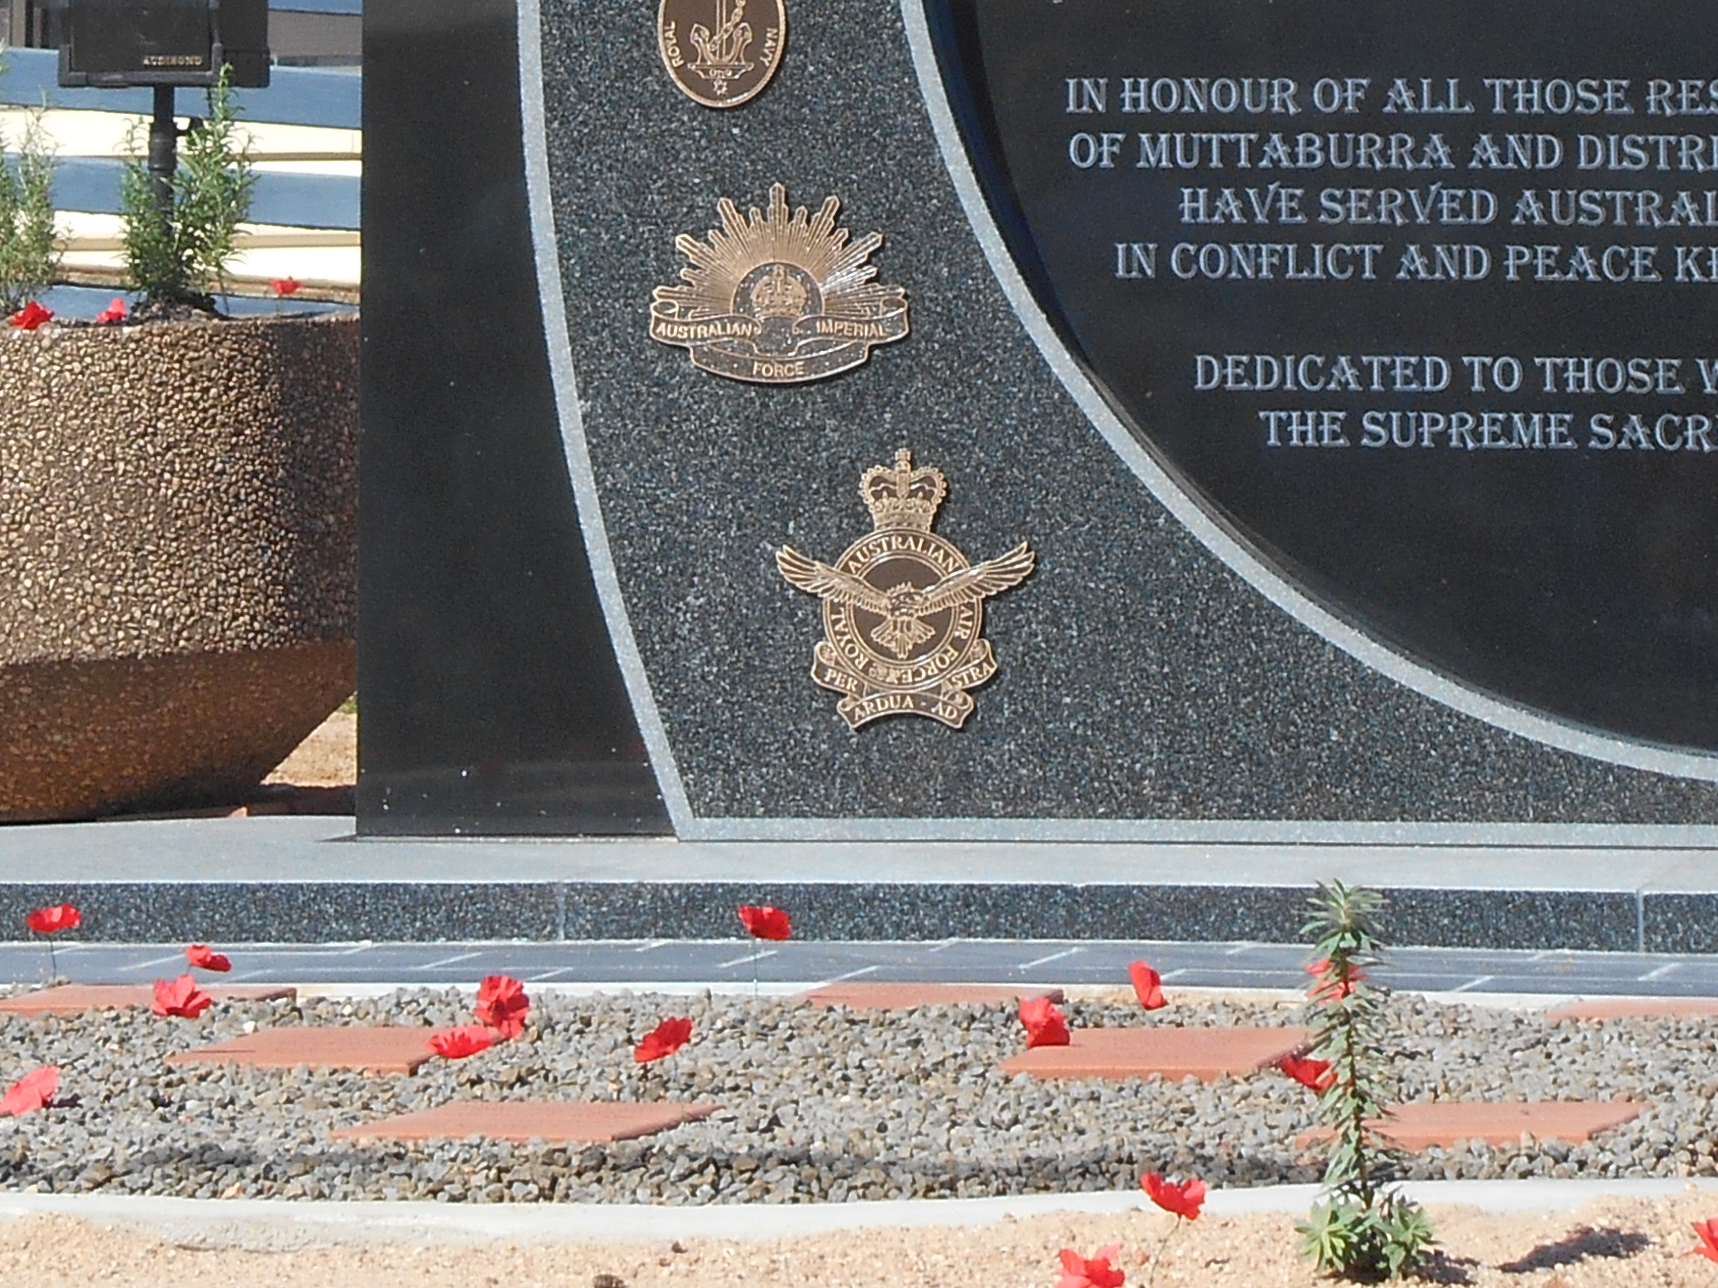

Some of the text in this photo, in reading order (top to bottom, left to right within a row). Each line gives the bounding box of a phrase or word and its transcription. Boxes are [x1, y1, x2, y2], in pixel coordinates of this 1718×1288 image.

[664, 21, 684, 68] ROYAL
[759, 27, 778, 67] NAVY
[1065, 77, 1109, 114] IN
[1119, 77, 1303, 116] HONOUR
[1312, 77, 1372, 114] OF
[1382, 77, 1475, 114] ALL
[1482, 78, 1635, 115] THOSE
[1068, 132, 1127, 169] OF
[1135, 132, 1456, 171] MUTTABURRA
[1467, 133, 1564, 170] AND
[1178, 181, 1308, 224] HAVE
[1317, 181, 1498, 227] SERVED
[1114, 242, 1158, 279] IN
[1170, 242, 1384, 280] CONFLICT
[1395, 244, 1492, 281] AND
[1503, 244, 1663, 283] PEACE
[655, 320, 887, 339] AUSTRALIAN IMPERIAL
[753, 361, 805, 377] FORCE
[1193, 354, 1452, 392] DEDICATED
[1460, 355, 1523, 393] TO
[1533, 356, 1686, 394] THOSE
[1257, 410, 1351, 448] THE
[1360, 410, 1579, 451] SUPREME
[831, 535, 974, 683] ROYAL AUSTRALIAN AIR FORCE
[824, 668, 858, 692] PER
[854, 695, 914, 721] ARDUA
[930, 701, 958, 719] AD
